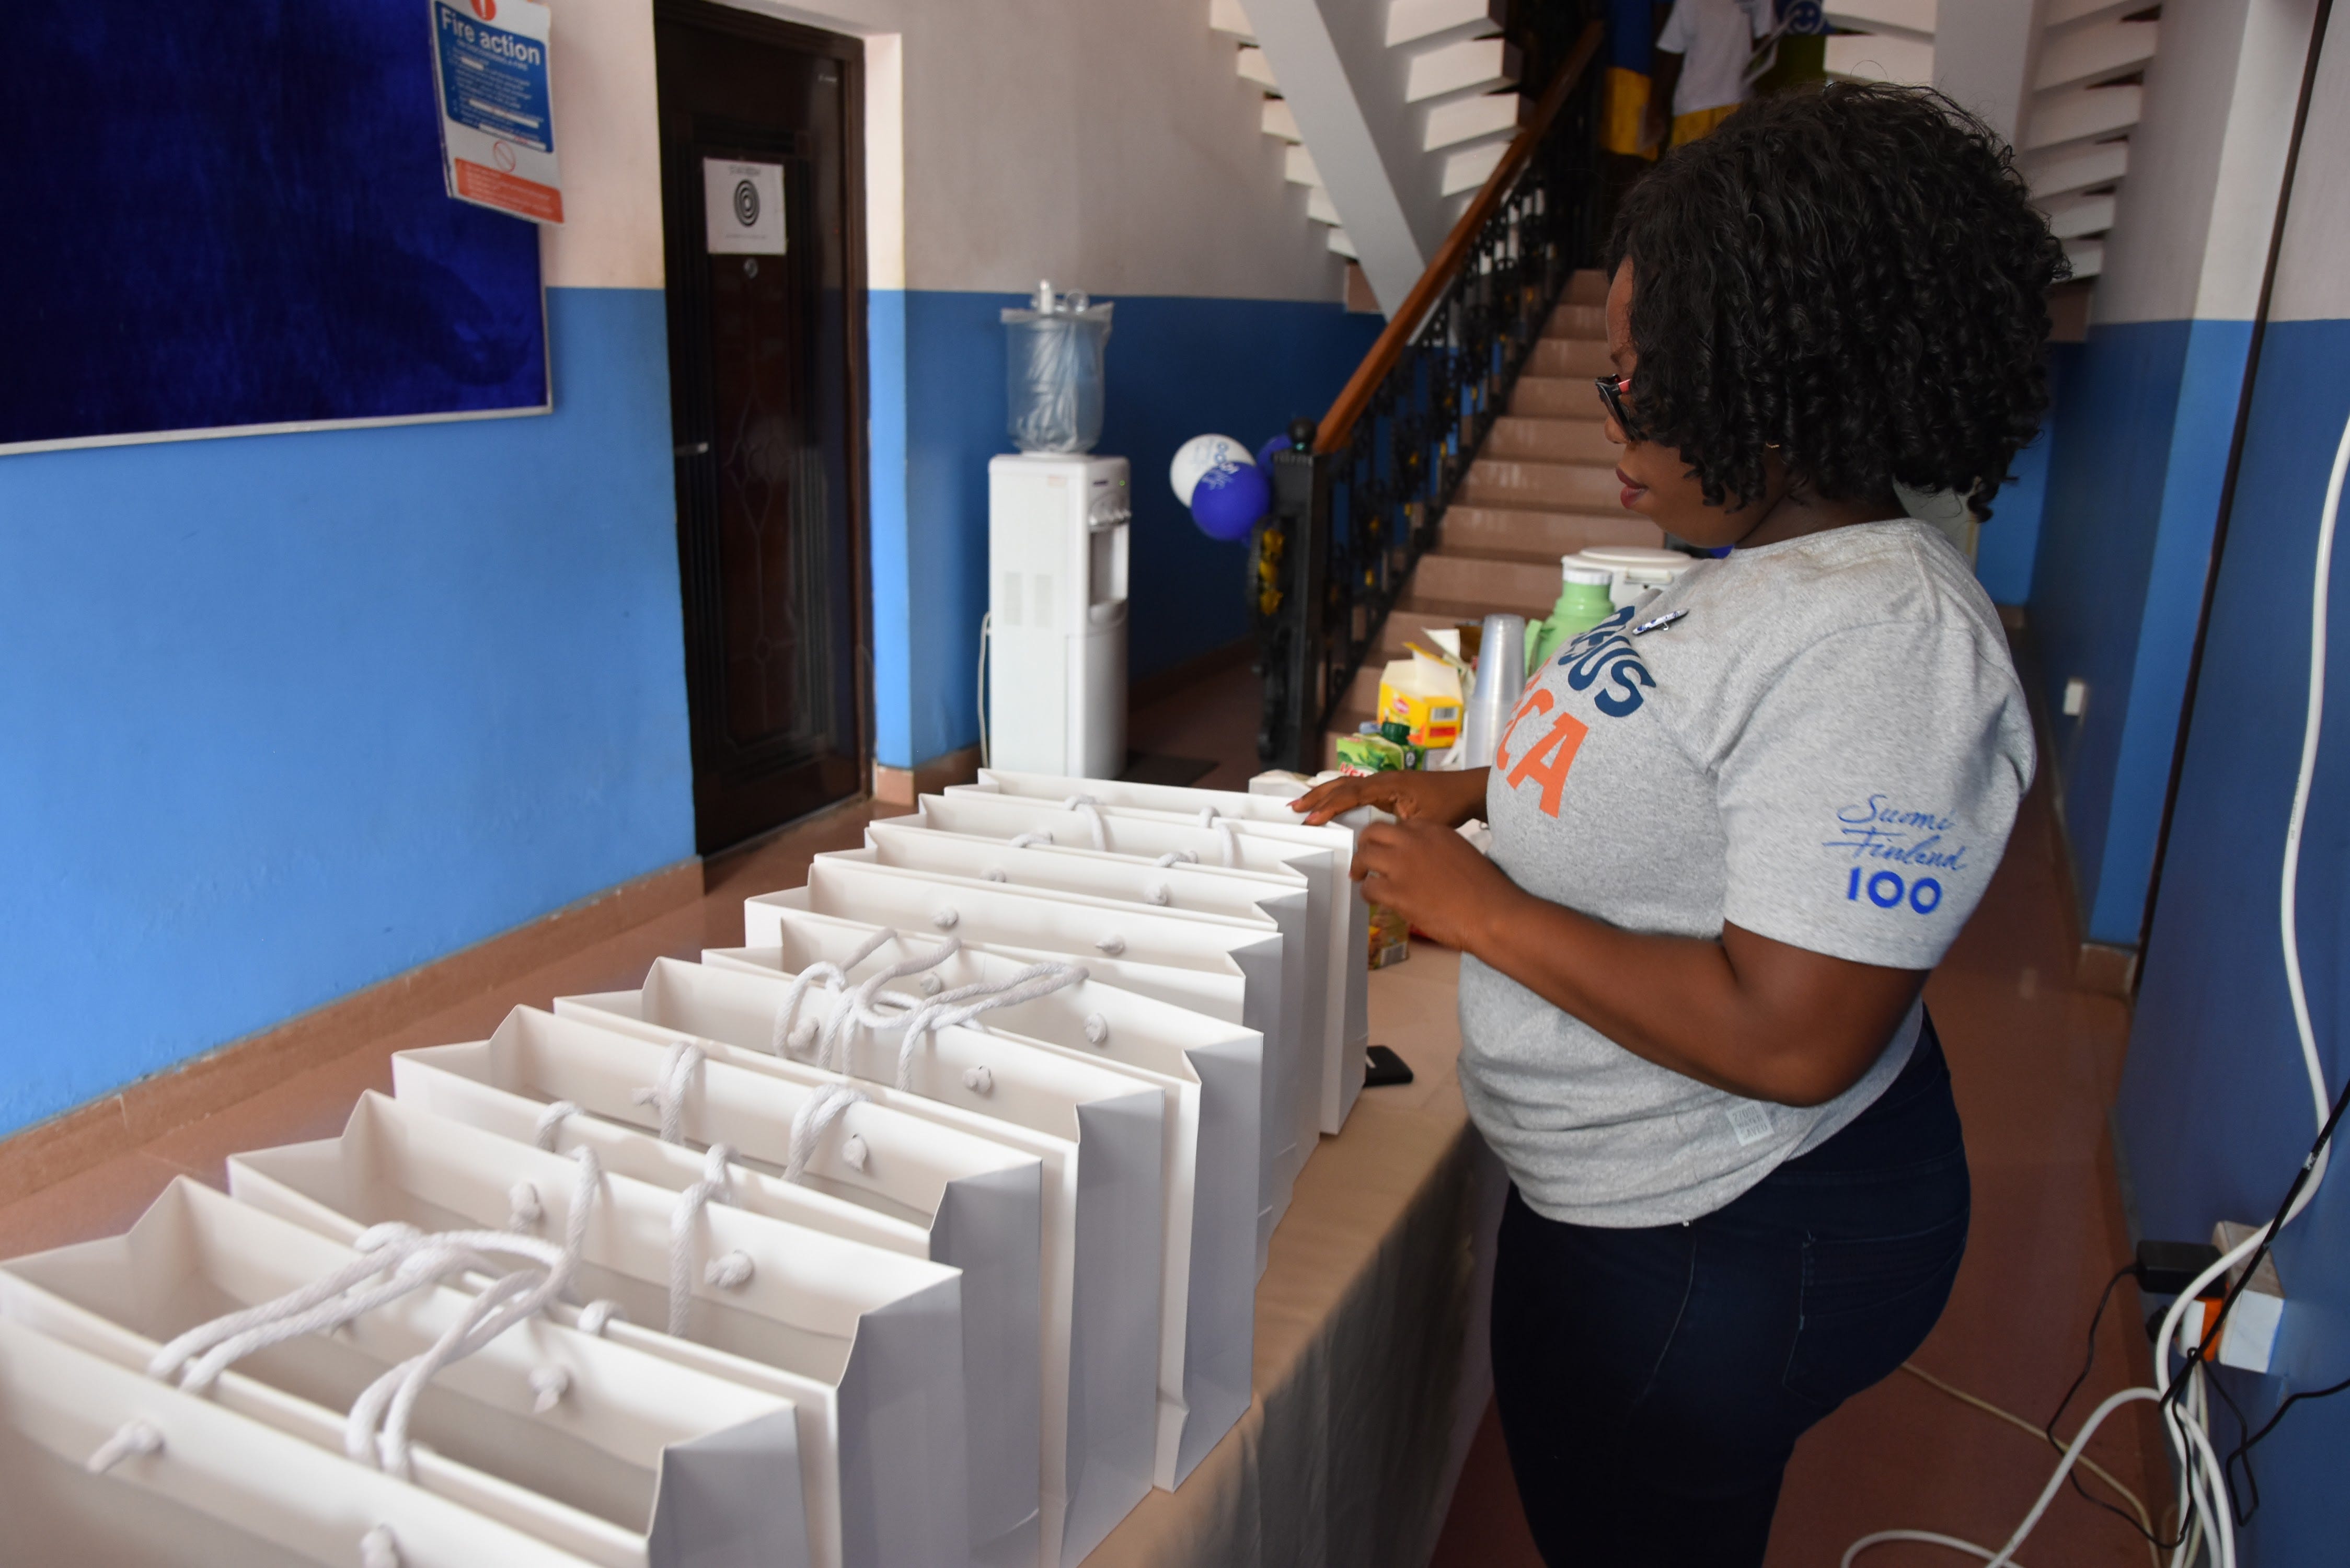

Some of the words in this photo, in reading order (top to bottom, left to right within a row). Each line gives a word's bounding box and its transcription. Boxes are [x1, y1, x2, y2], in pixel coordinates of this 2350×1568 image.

[442, 8, 474, 42] Fire
[480, 32, 540, 65] action
[1848, 866, 1942, 915] 100
